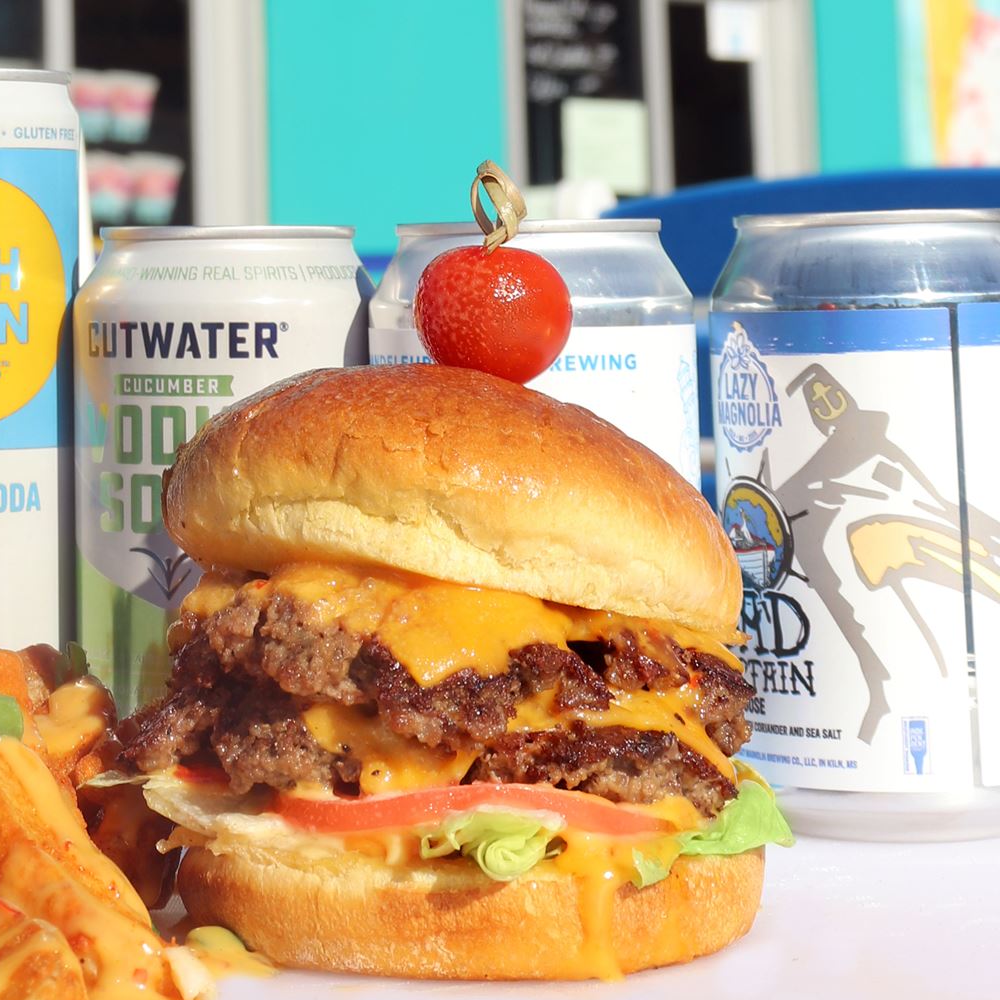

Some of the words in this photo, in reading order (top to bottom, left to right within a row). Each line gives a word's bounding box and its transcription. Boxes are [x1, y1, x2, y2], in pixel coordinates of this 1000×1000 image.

[14, 127, 58, 140] GLUTEN
[59, 128, 75, 141] FREE
[203, 266, 240, 281] REAL
[244, 266, 298, 280] SPIRITS
[550, 354, 637, 372] REWING
[123, 378, 219, 394] CUCUMBER
[725, 373, 758, 400] LAZY
[718, 401, 782, 427] MAGNOLIA
[745, 697, 766, 715] OSE
[755, 722, 788, 736] CORIANDER
[789, 727, 804, 738] AND
[806, 728, 821, 739] SEA
[823, 728, 842, 740] SALT
